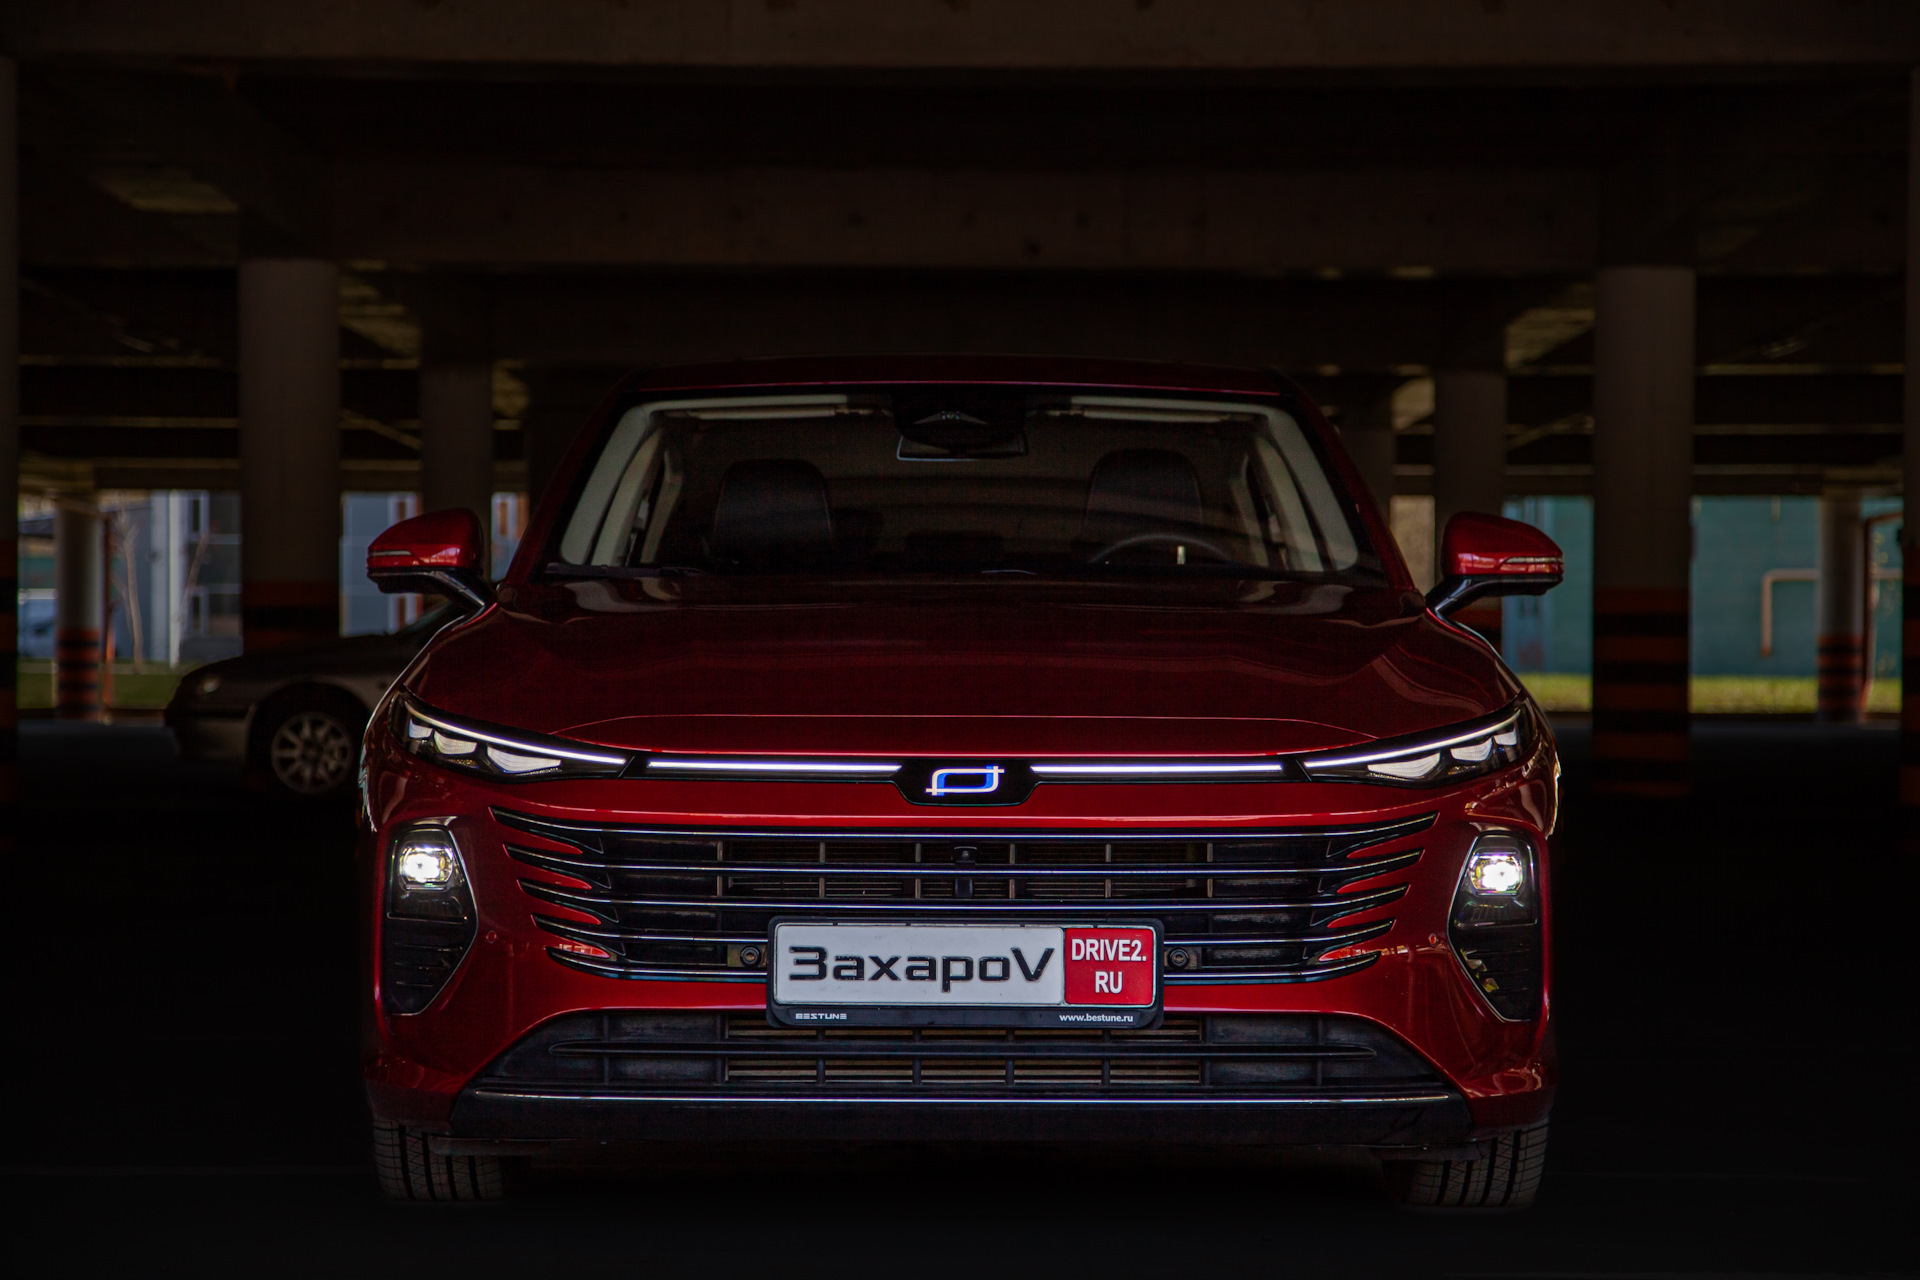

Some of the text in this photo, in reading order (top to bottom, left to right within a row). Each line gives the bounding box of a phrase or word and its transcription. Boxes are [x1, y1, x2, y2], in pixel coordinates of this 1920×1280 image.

[1072, 939, 1146, 961] DRIVE2.
[1095, 971, 1123, 993] RU
[1059, 1013, 1133, 1022] www.bestune.ru
